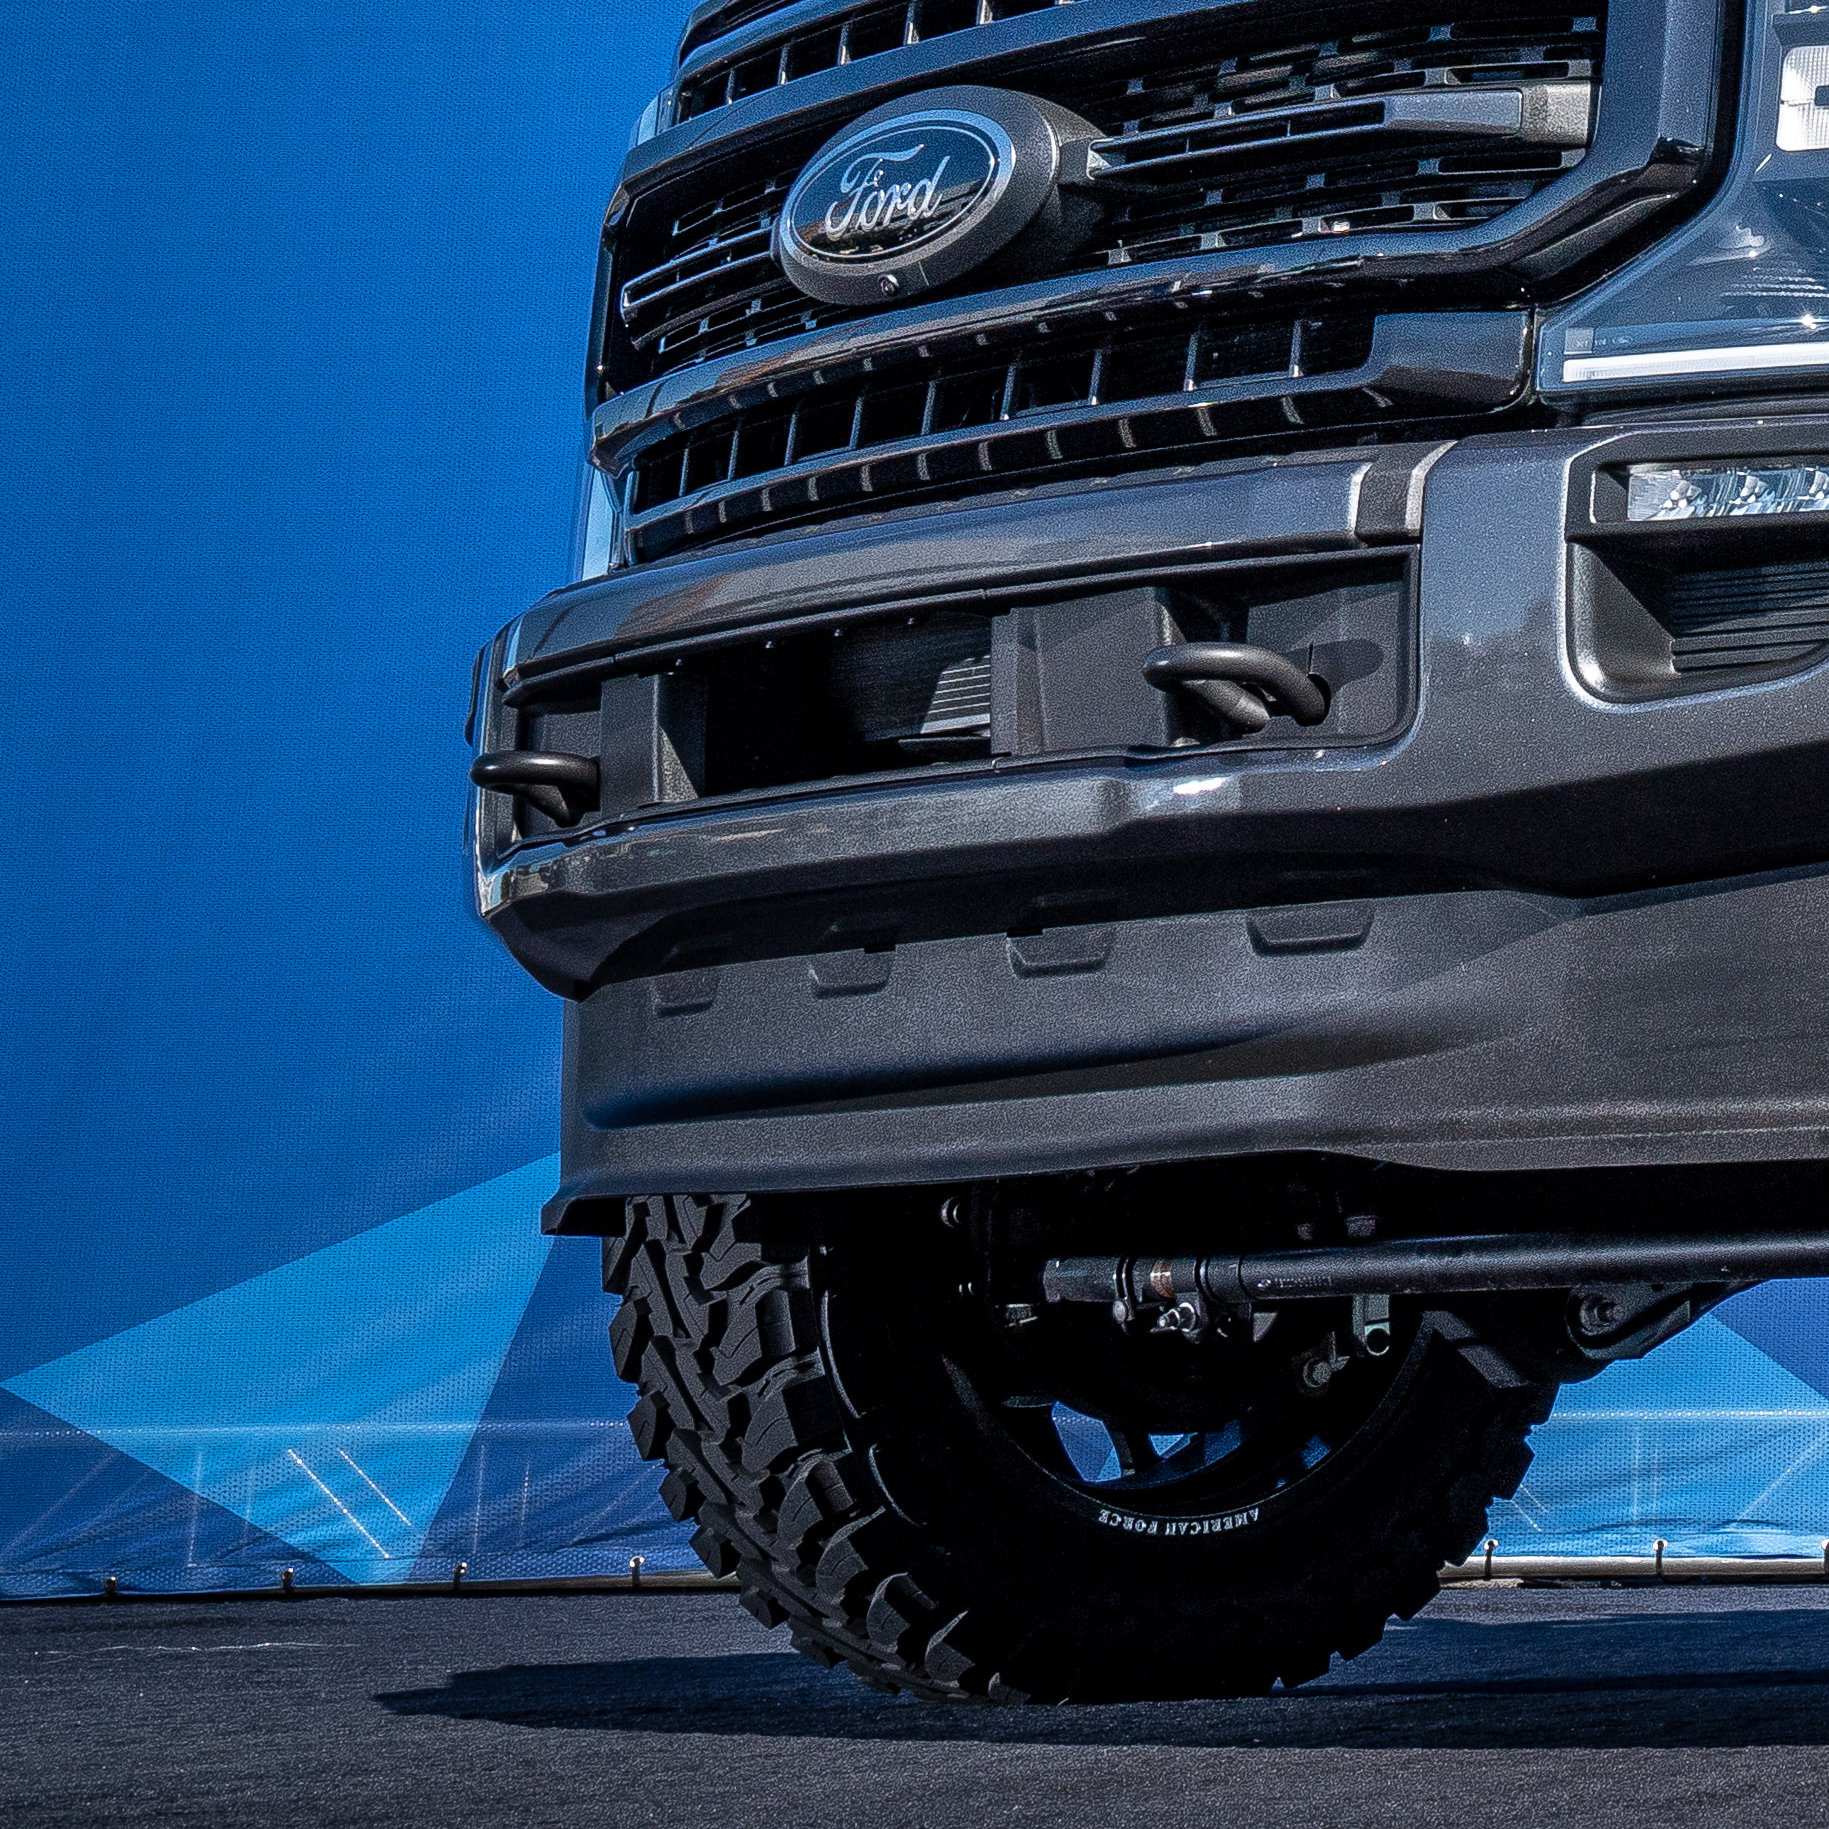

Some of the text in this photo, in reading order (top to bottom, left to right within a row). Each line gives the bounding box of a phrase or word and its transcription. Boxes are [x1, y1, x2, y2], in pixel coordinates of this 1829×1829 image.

[825, 142, 951, 241] Ford
[1097, 1507, 1260, 1537] AMERICAN FORCE
